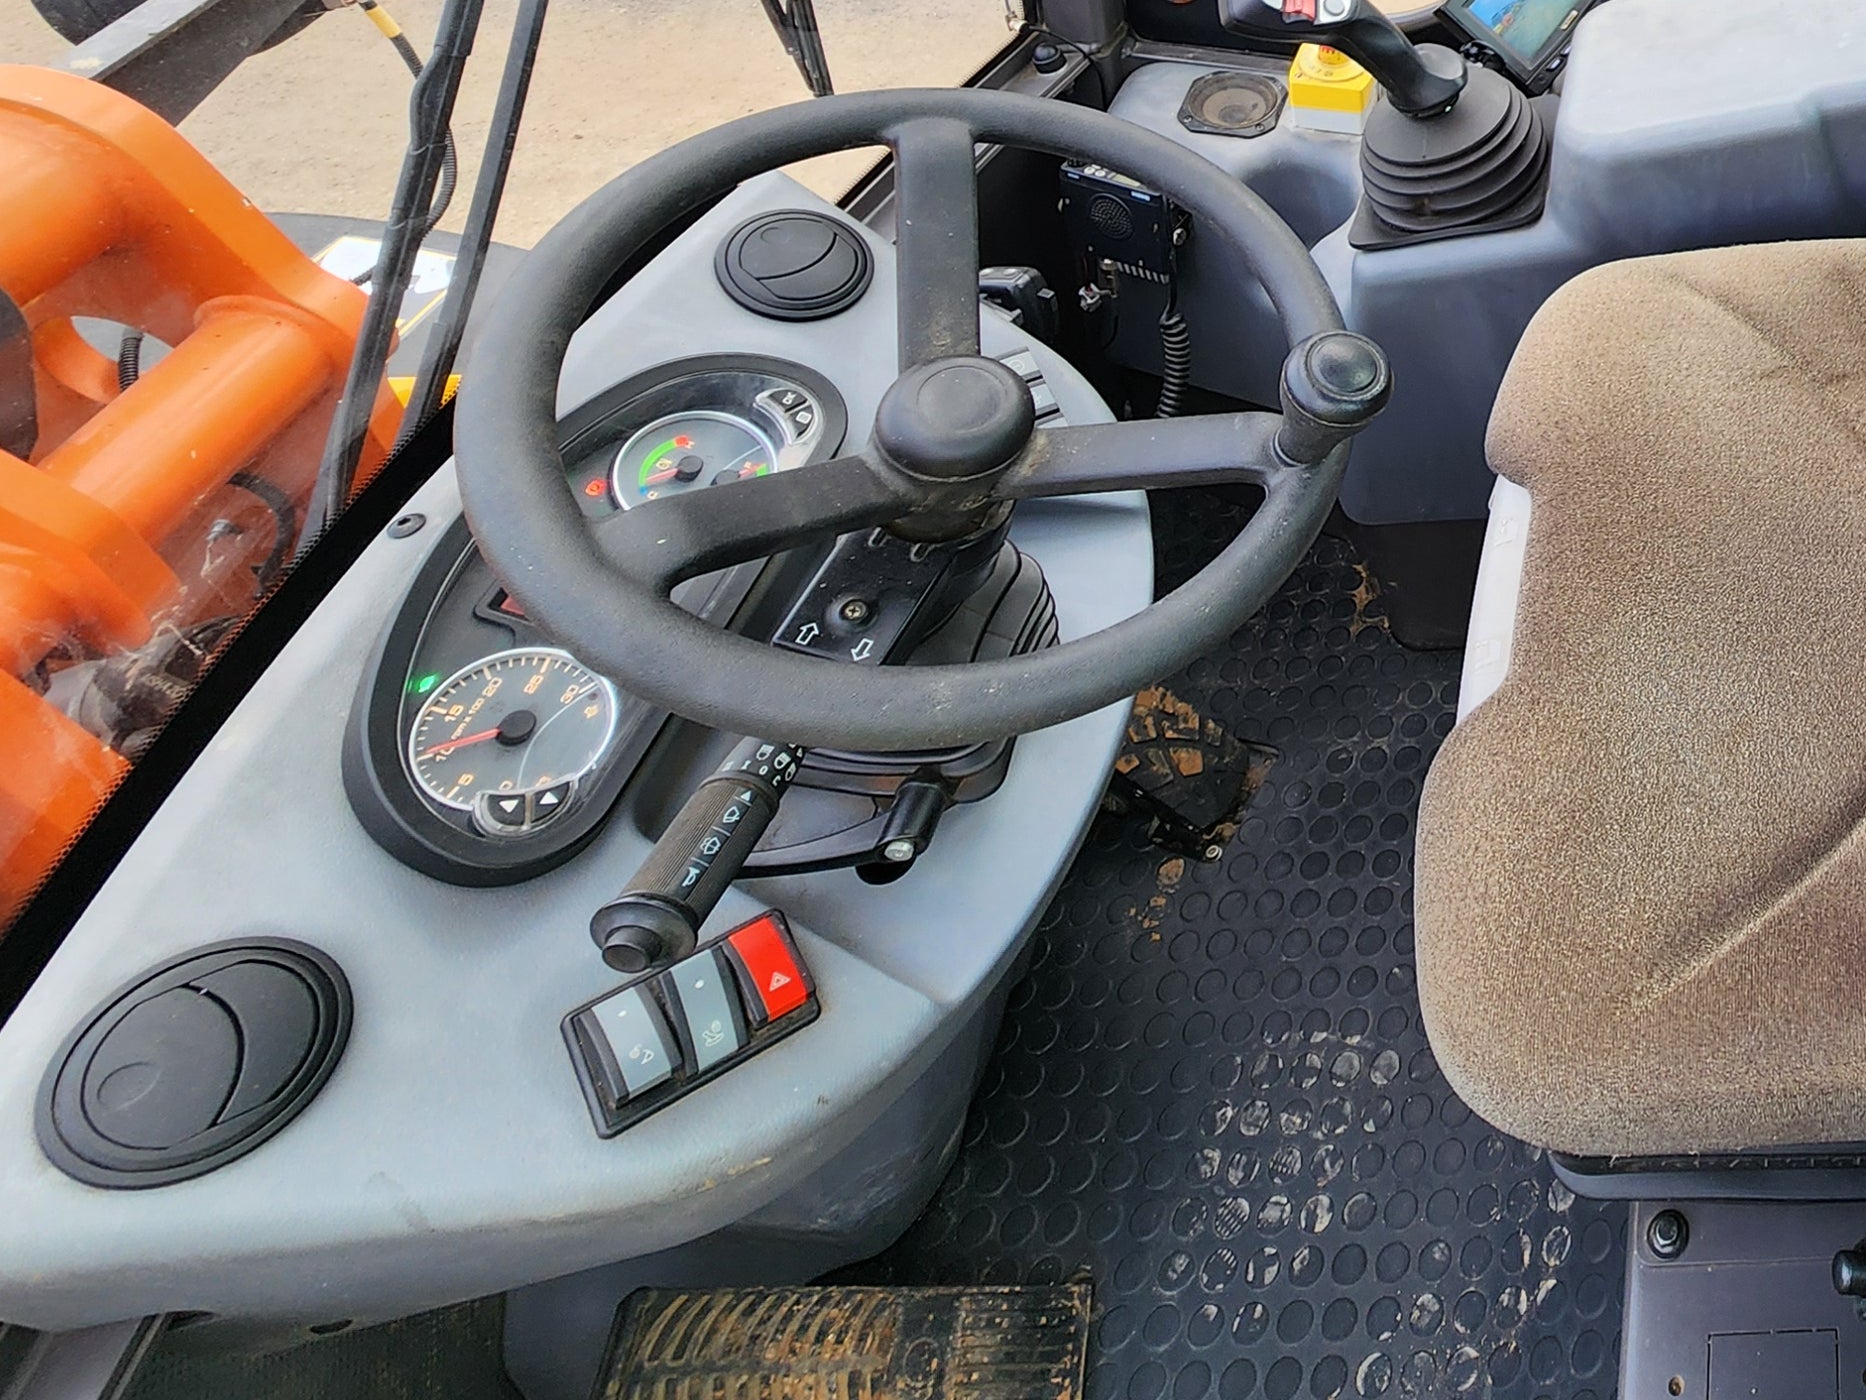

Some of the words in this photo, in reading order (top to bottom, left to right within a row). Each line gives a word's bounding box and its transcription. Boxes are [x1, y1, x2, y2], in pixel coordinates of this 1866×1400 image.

[482, 677, 502, 698] 20
[523, 674, 544, 695] 25
[560, 684, 579, 704] 30
[444, 704, 464, 722] 15
[468, 697, 485, 716] 100
[457, 773, 474, 786] 5
